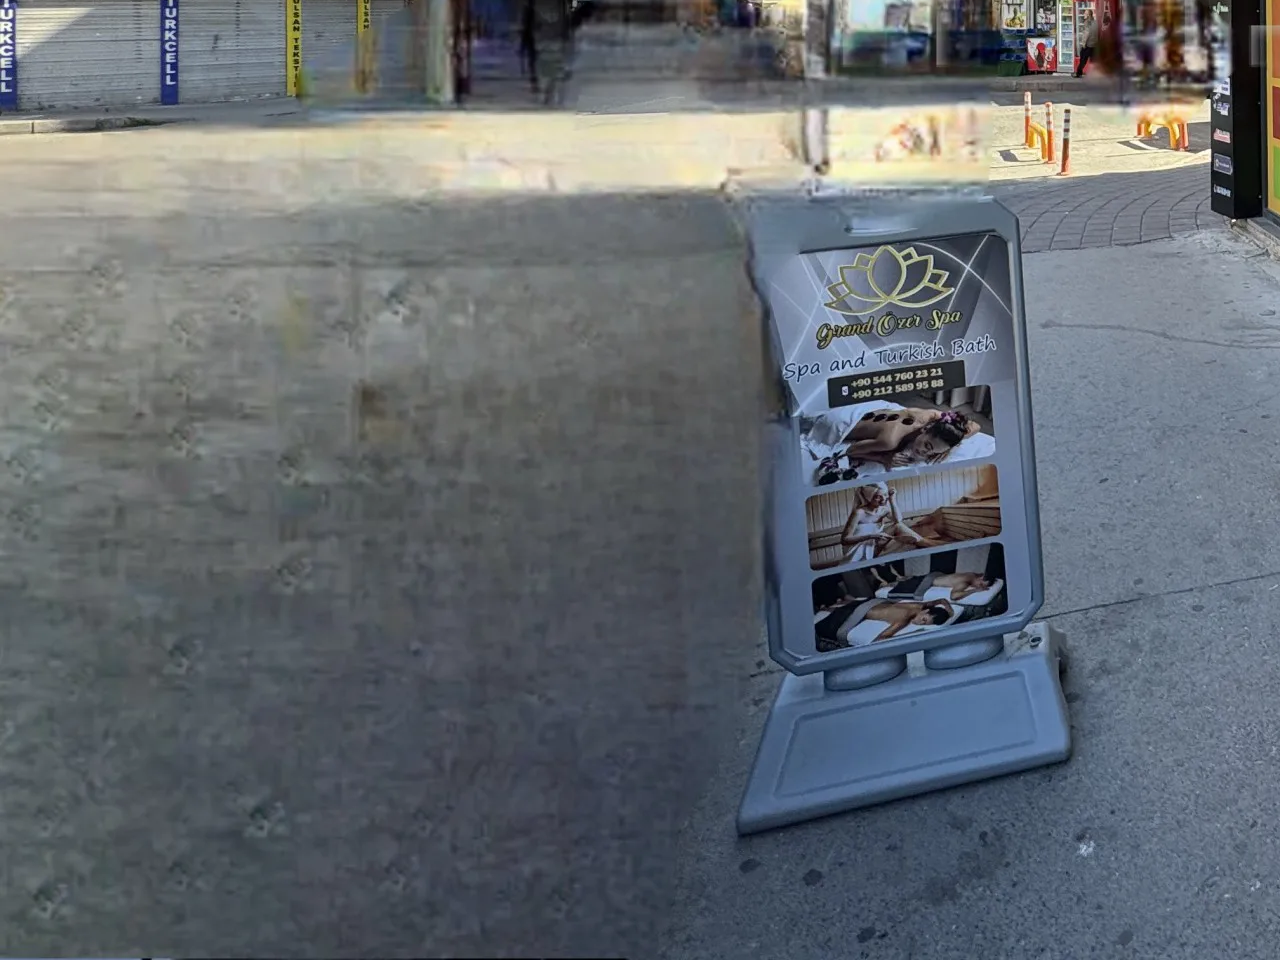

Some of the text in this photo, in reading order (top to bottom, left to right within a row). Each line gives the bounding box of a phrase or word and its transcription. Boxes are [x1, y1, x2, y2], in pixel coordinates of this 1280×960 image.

[816, 308, 962, 350] Grand Özer Spa
[783, 335, 997, 384] Spa and Turkish Bath
[851, 367, 943, 388] +90 544 760 23 21
[851, 379, 944, 399] +90 212 589 95 88
